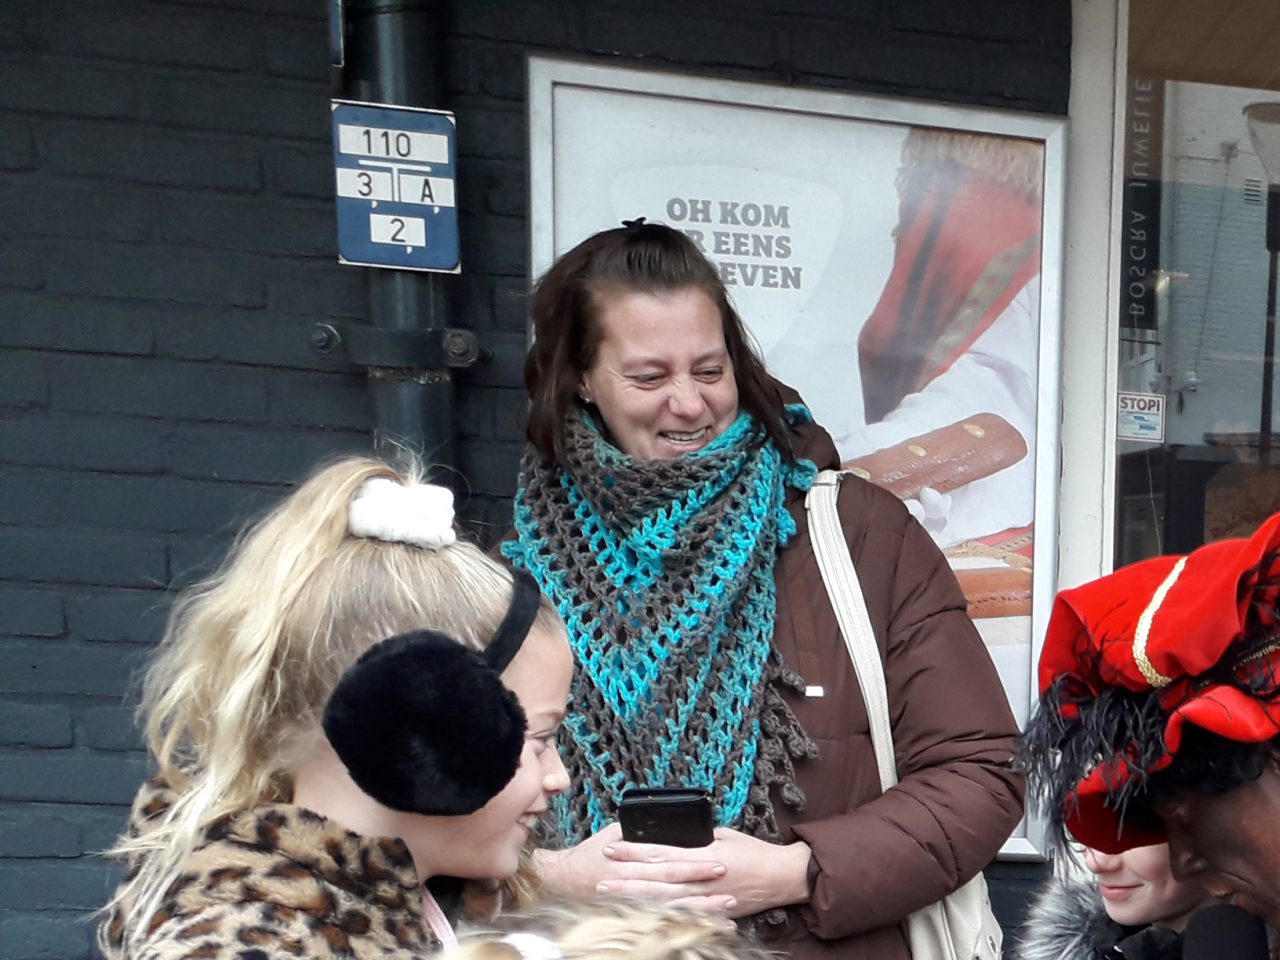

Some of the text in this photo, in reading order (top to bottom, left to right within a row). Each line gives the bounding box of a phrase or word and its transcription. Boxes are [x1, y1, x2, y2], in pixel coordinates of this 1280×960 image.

[362, 129, 411, 157] 110
[357, 172, 435, 203] 3 A
[666, 197, 790, 229] OH KOM
[390, 218, 406, 243] 2
[677, 229, 792, 259] R EENS
[719, 262, 802, 290] EVEN
[1120, 397, 1160, 412] STOP!
